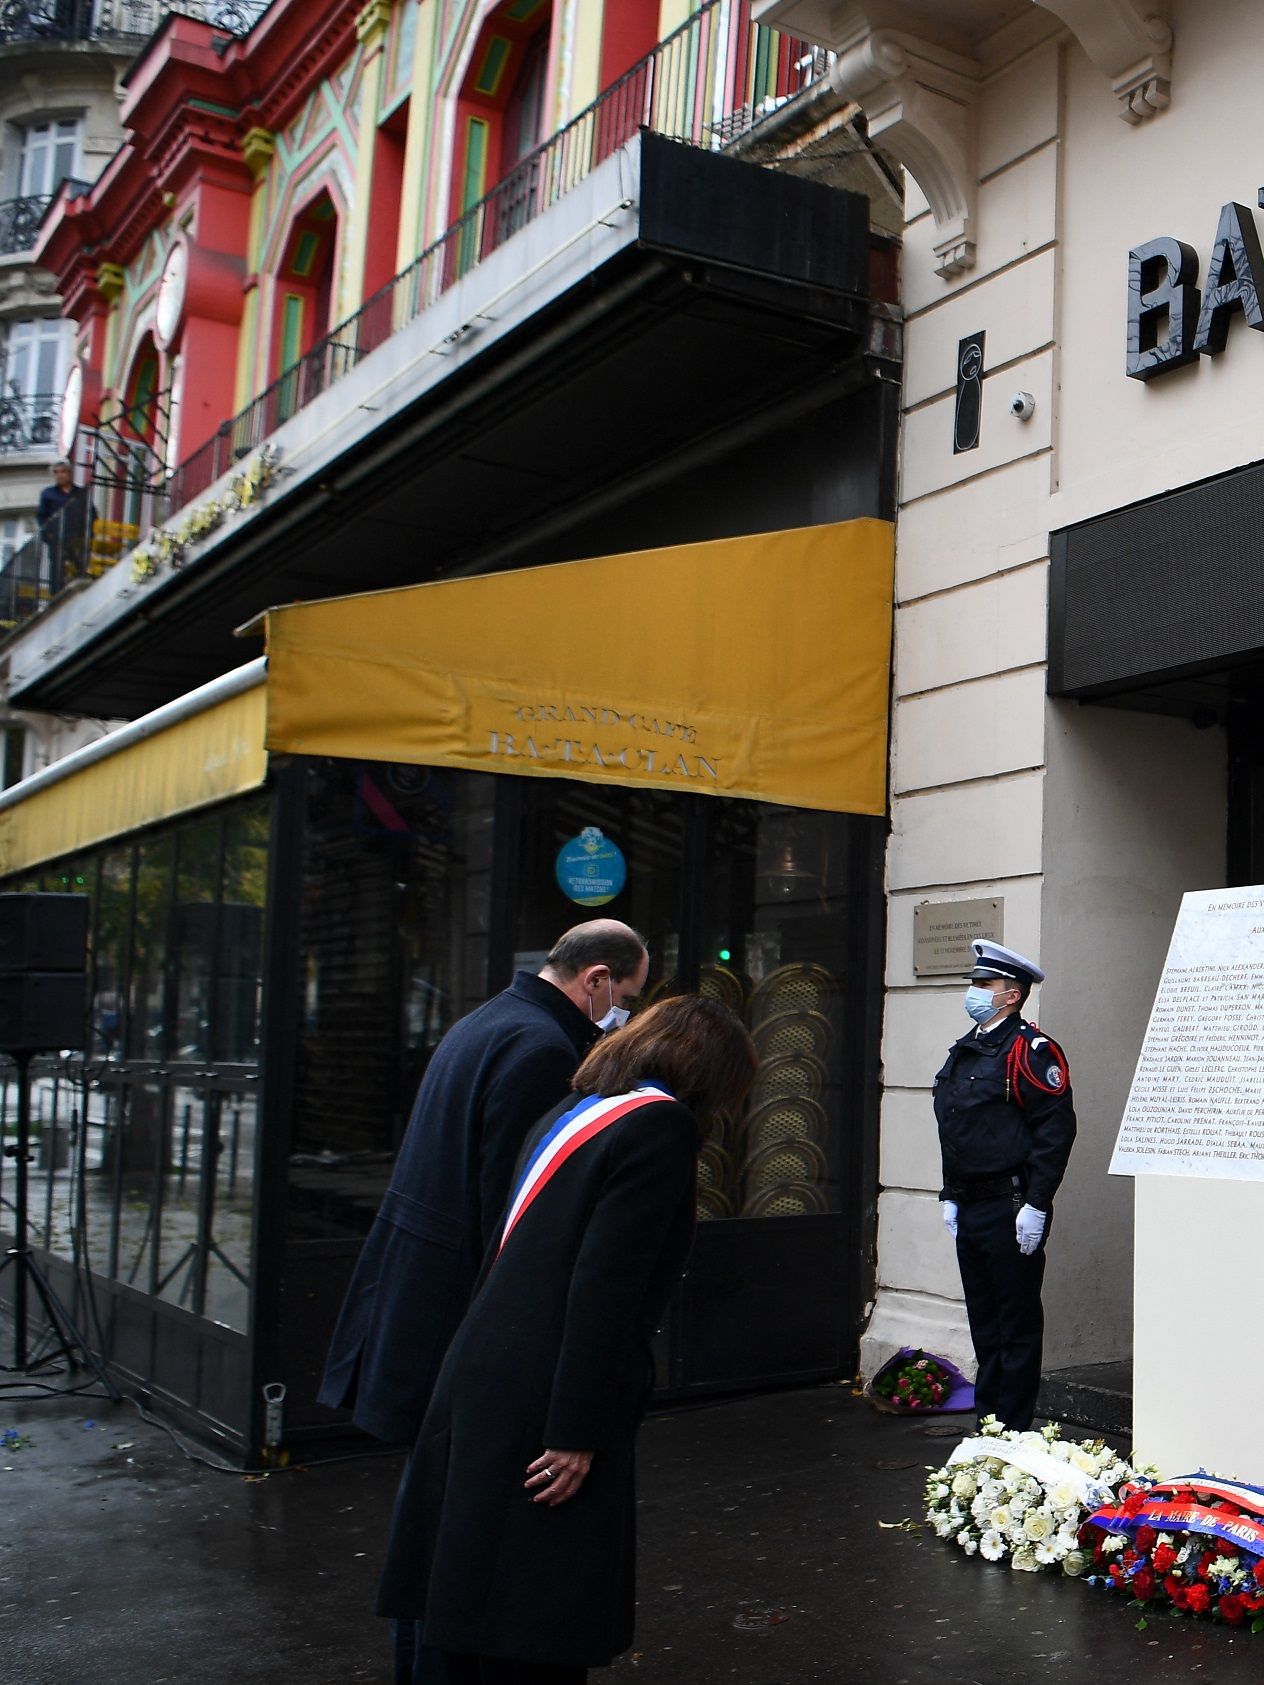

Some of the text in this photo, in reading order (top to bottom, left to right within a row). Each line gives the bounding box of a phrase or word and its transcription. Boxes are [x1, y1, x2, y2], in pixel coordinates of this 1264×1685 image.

[1147, 1509, 1164, 1523] LA
[1200, 1513, 1220, 1528] DE
[1221, 1520, 1260, 1543] PARIS
